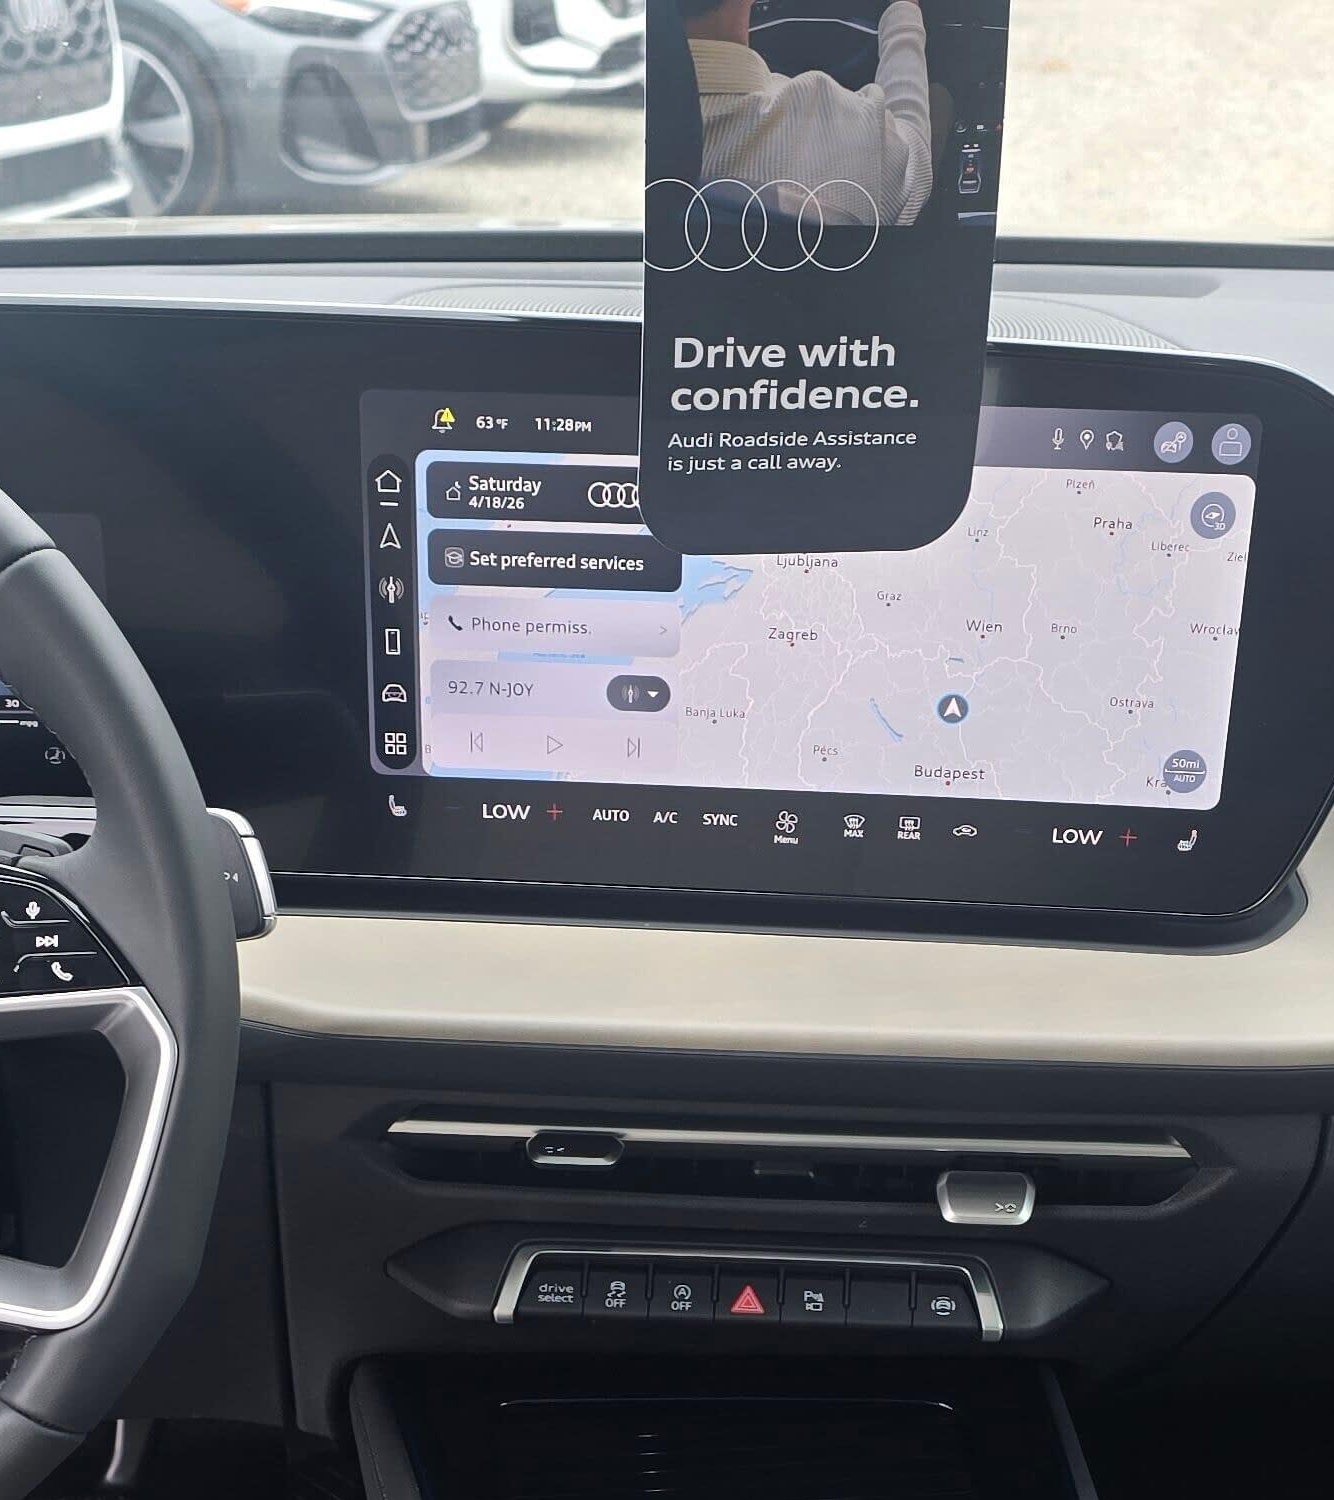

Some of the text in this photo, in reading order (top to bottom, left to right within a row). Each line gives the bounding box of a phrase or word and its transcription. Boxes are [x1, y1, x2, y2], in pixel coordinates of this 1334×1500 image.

[674, 336, 896, 368] Drive with
[671, 379, 919, 411] confidence.
[668, 430, 917, 448] Audi Roadside Assistance
[668, 454, 842, 474] is just a call away.
[469, 475, 542, 496] Saturday
[468, 496, 525, 509] 4/18/26
[1094, 517, 1133, 530] Praha
[968, 527, 988, 537] Linz
[1151, 541, 1190, 551] Liberec
[470, 551, 644, 571] Set preferred services
[776, 555, 838, 568] Ljubljana
[877, 591, 902, 601] Graz
[472, 617, 592, 635] Phone permiss.
[966, 620, 1003, 633] Wien
[1051, 623, 1078, 634] Brno
[768, 628, 818, 643] Zagreb
[448, 681, 534, 697] 92.7 N-JOY
[5, 699, 20, 708] 30
[1110, 697, 1154, 709] Ostrava
[685, 707, 746, 719] Banja Luka
[915, 765, 986, 781] Budapest
[1173, 774, 1196, 783] AUTO
[482, 804, 531, 820] LOW
[592, 809, 630, 822] AUTO
[653, 811, 678, 824] A/C
[702, 814, 738, 827] SYNC
[774, 834, 798, 844] Menu
[844, 829, 864, 838] MAX
[897, 831, 921, 840] REAR
[1052, 828, 1103, 844] LOW
[539, 1283, 574, 1294] drive
[538, 1293, 574, 1303] select
[605, 1298, 627, 1308] OFF
[671, 1301, 693, 1311] OFF
